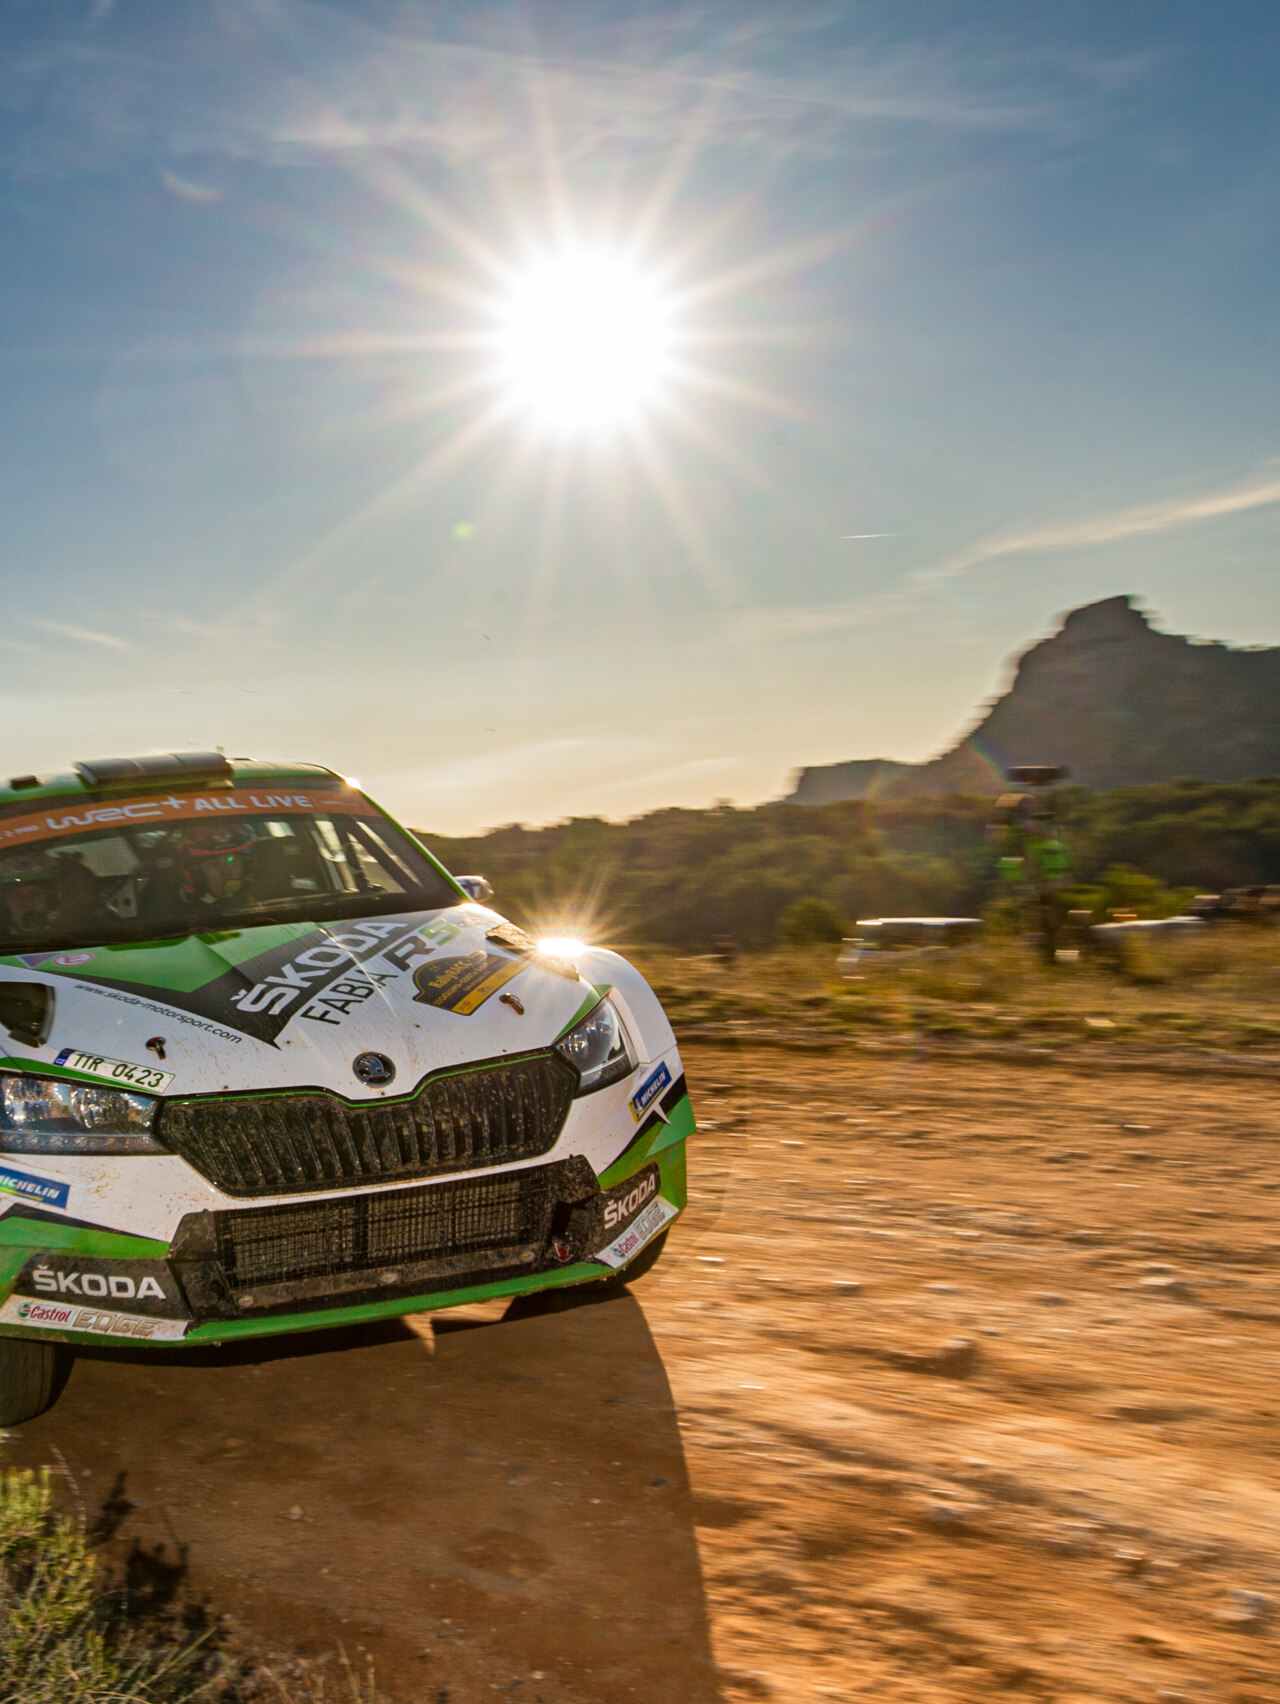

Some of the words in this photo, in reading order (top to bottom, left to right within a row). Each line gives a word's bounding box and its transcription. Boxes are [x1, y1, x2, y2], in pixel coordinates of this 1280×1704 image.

[194, 796, 248, 811] ALL
[250, 795, 314, 808] LIVE
[230, 921, 408, 1016] ŠKODA
[301, 970, 399, 1025] FABIA
[382, 918, 462, 972] R5
[111, 1063, 164, 1088] 0423
[641, 1071, 666, 1106] MICHELIN
[603, 1173, 656, 1230] ŠKODA
[617, 1232, 640, 1254] Castrol
[32, 1264, 167, 1300] ŠKODA
[30, 1305, 72, 1323] Castrol
[73, 1309, 162, 1337] EDGE
